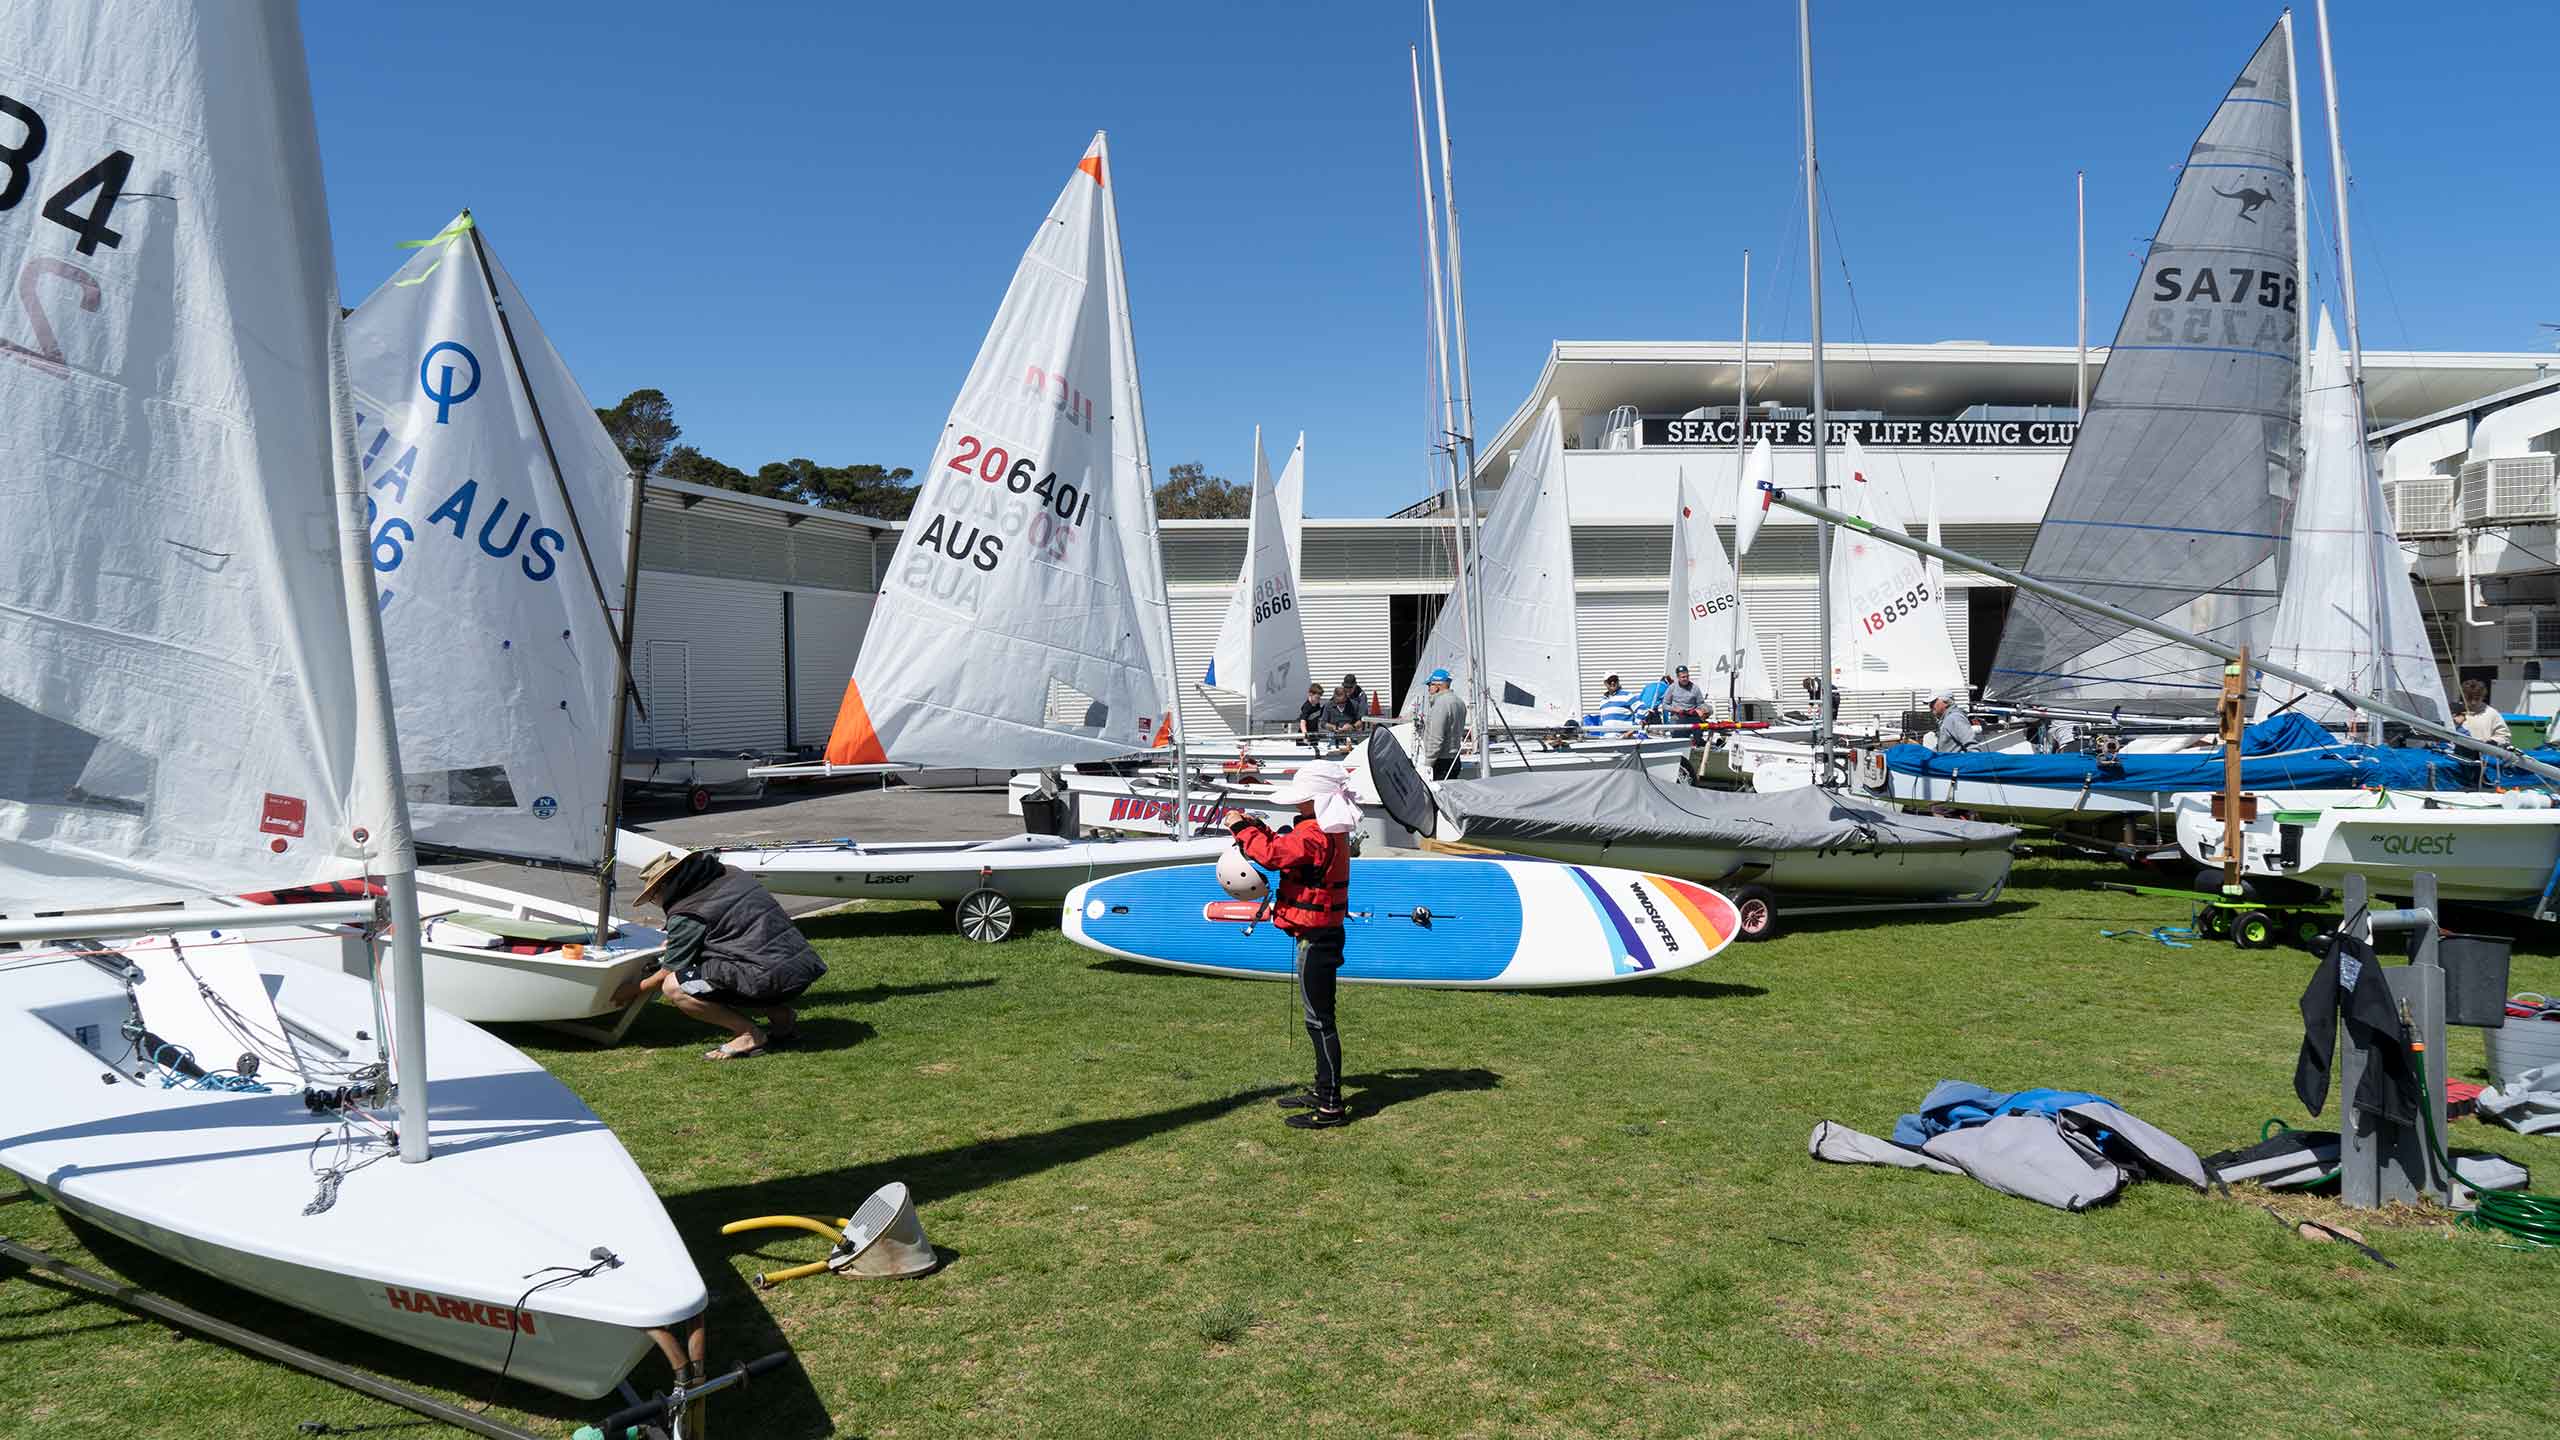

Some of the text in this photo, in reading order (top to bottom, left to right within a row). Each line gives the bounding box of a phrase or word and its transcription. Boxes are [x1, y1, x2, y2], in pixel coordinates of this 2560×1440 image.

[1869, 422, 1921, 443] LIFE
[1929, 422, 2021, 444] SAVING
[2028, 423, 2081, 444] CLU
[947, 435, 1091, 527] 206401
[426, 478, 565, 581] AUS
[917, 513, 1004, 572] AUS
[1252, 592, 1291, 627] 8666
[1862, 582, 1930, 636] 188595
[2383, 832, 2457, 856] Quest
[864, 872, 915, 885] Laser
[1629, 881, 1679, 953] WINDSURFER
[385, 1286, 537, 1336] HARKEN
